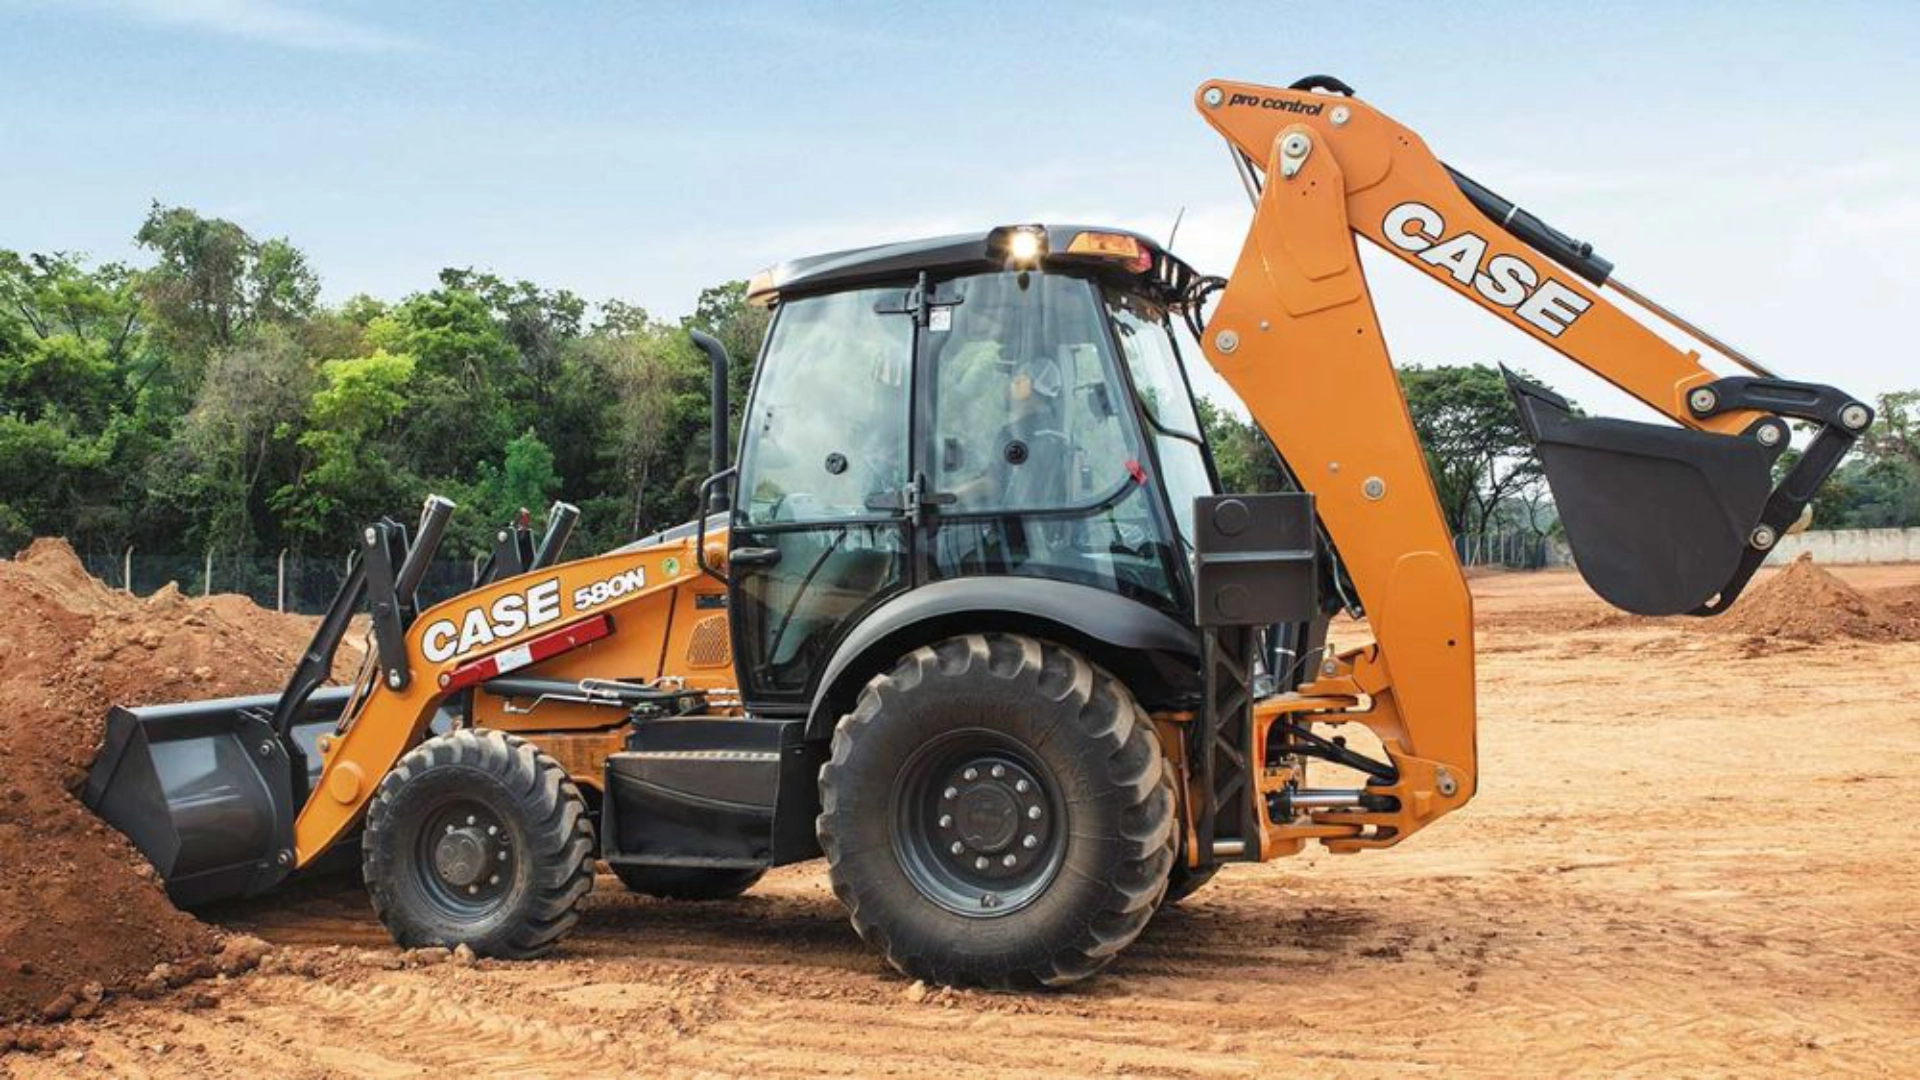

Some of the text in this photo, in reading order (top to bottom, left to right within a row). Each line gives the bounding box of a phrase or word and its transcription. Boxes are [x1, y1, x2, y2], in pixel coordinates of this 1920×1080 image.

[1228, 93, 1324, 116] pro control
[1382, 201, 1593, 339] CASE
[421, 565, 646, 664] CASE 580N
